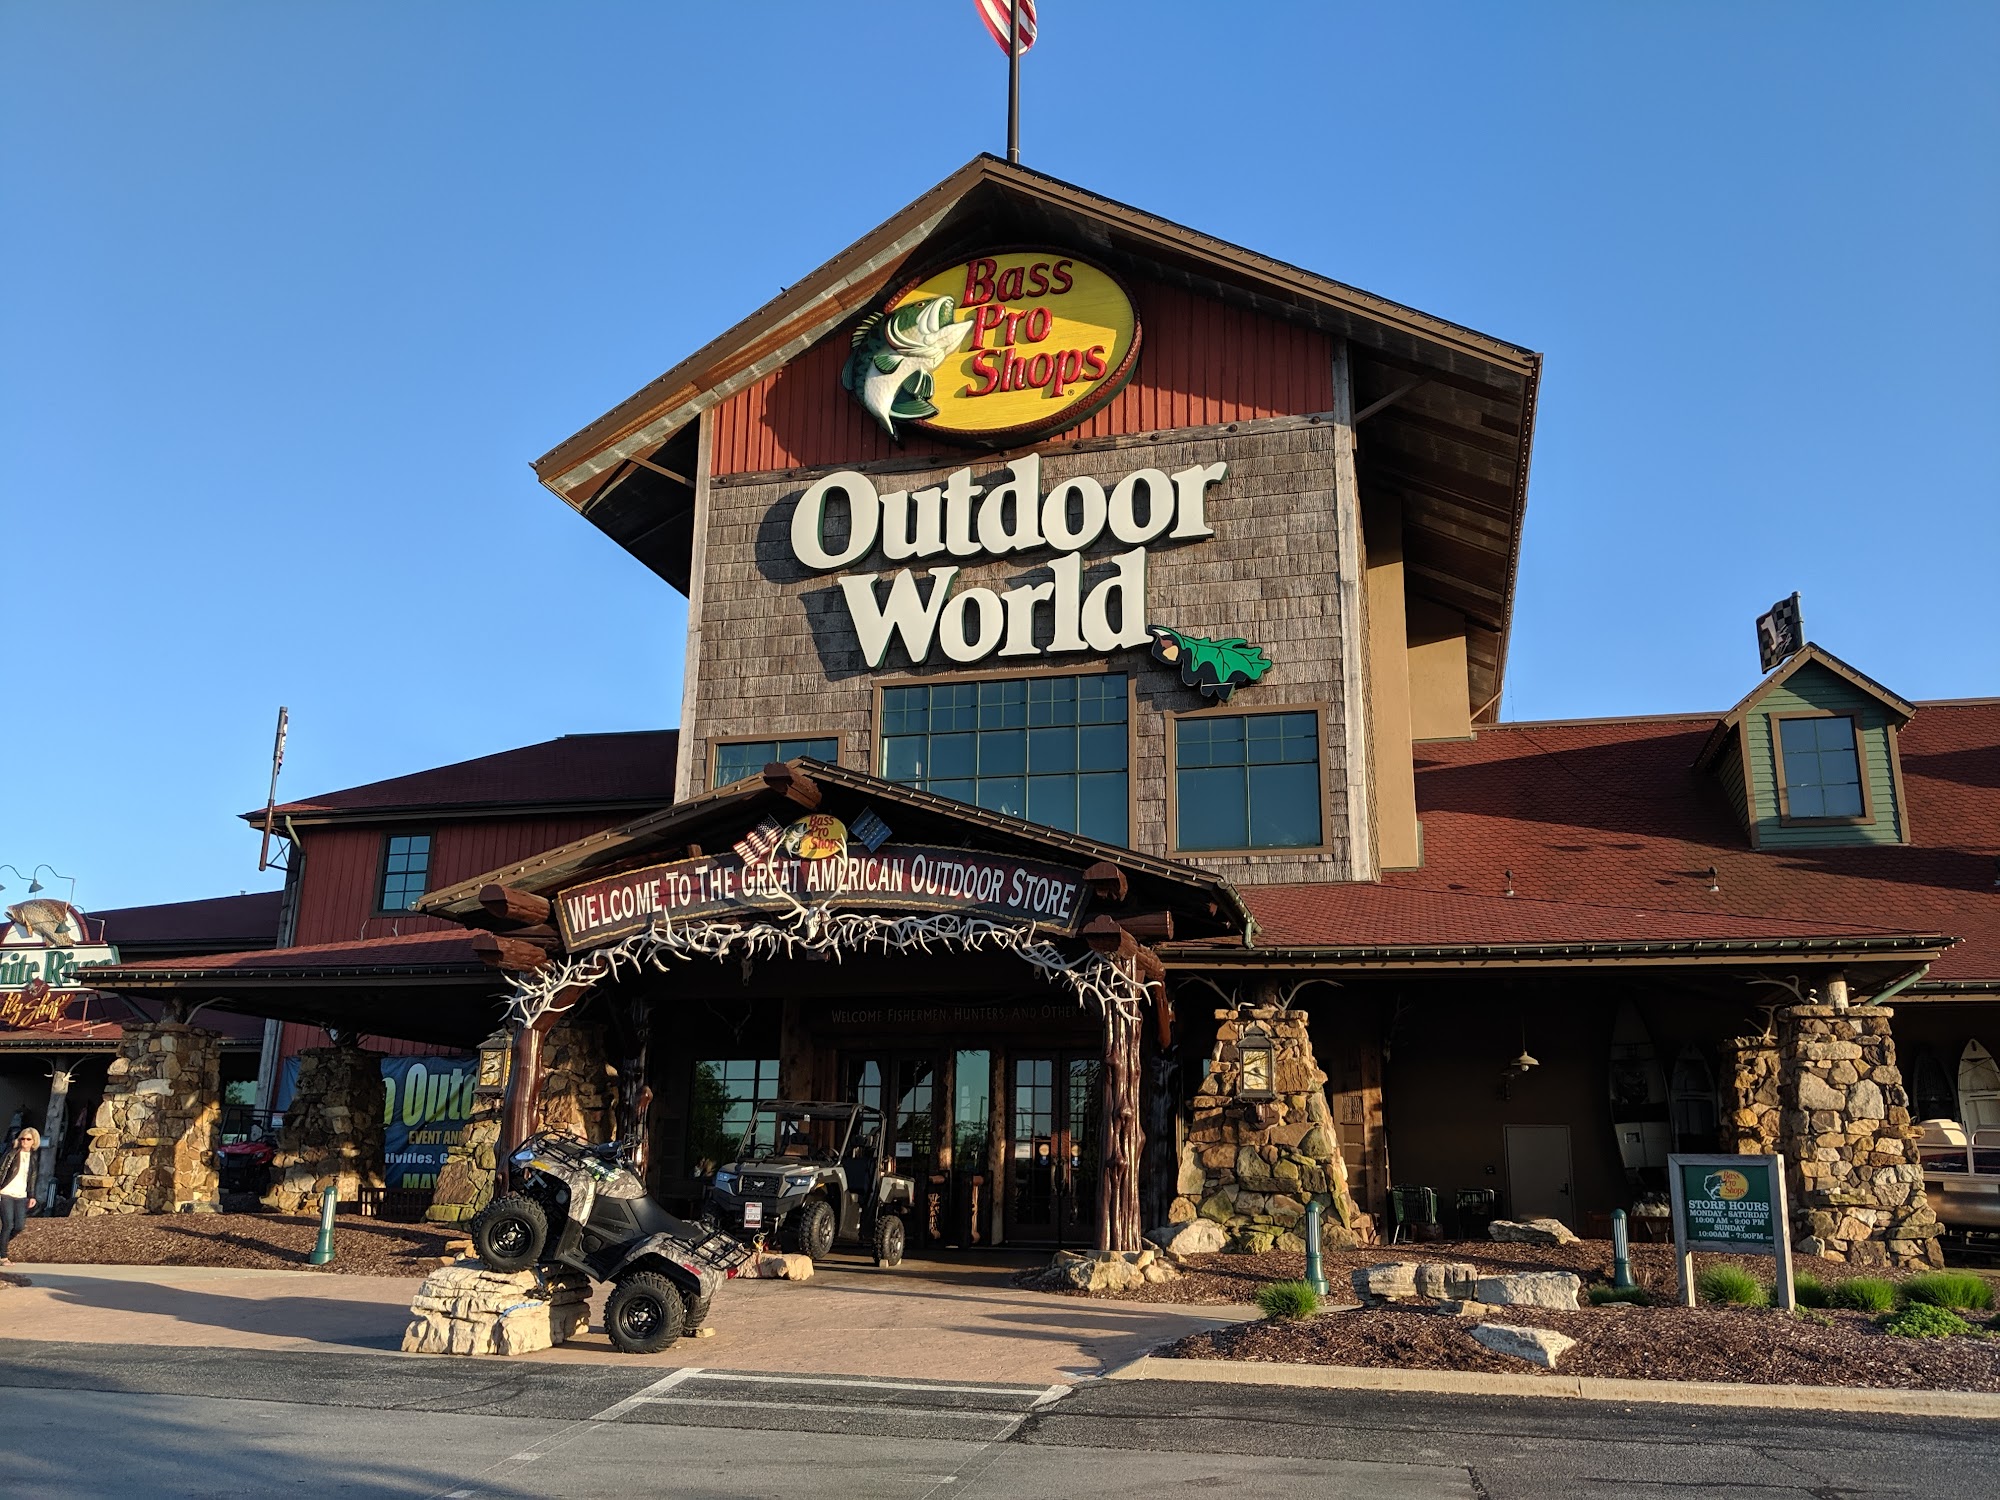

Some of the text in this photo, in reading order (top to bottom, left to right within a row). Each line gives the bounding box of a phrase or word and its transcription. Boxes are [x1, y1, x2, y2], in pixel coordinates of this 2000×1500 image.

[960, 258, 1074, 308] Bass
[969, 304, 1053, 351] Pro
[965, 344, 1108, 398] Shops
[791, 452, 1228, 570] Outdoor
[838, 547, 1155, 668] World
[809, 815, 835, 827] Bass
[810, 826, 829, 838] Pro
[567, 878, 663, 934] WELCOME
[695, 864, 735, 903] THE
[741, 860, 800, 897] GREAT
[806, 856, 905, 893] AMERICAN
[911, 854, 1005, 904] OUTDOOR
[1007, 867, 1077, 920] STORE
[42, 951, 113, 987] Riv
[832, 1009, 882, 1024] WELCOME
[1012, 1006, 1037, 1020] AND
[1041, 1004, 1078, 1018] OTHER
[408, 1130, 442, 1145] EVENT
[1723, 1171, 1740, 1179] Bass
[1725, 1187, 1745, 1196] Shops
[1688, 1200, 1769, 1211] STORE HOURS
[1728, 1211, 1769, 1219] SATURDAY
